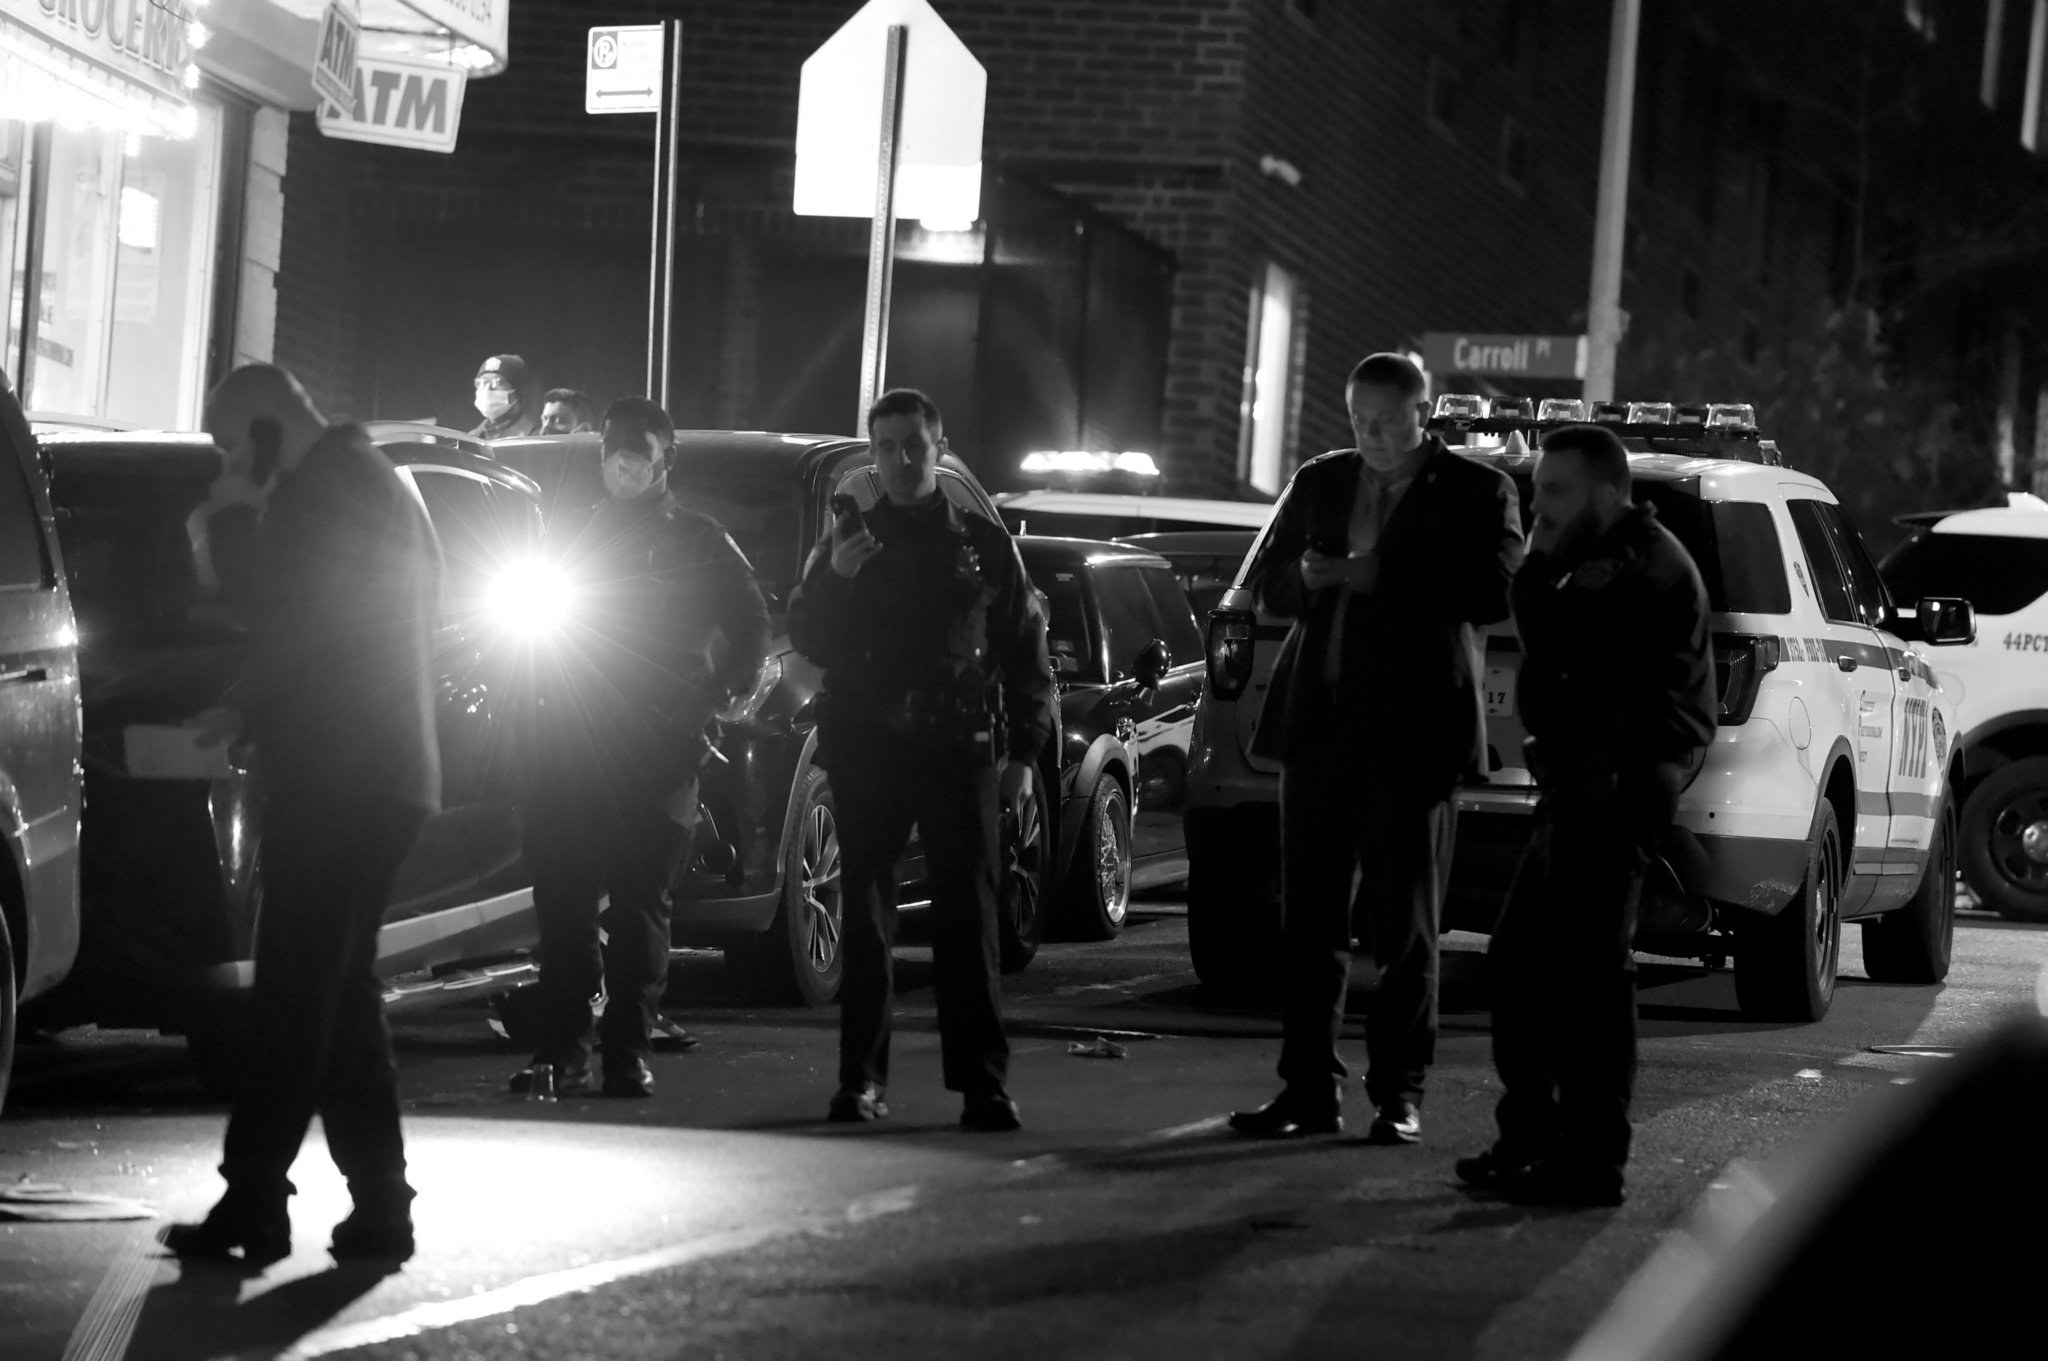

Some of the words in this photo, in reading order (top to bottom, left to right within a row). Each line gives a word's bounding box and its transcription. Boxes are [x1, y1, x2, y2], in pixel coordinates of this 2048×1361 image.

[39, 0, 184, 71] OCERY
[320, 11, 355, 89] ATM
[325, 67, 448, 134] ATM
[1454, 337, 1528, 370] Carroll
